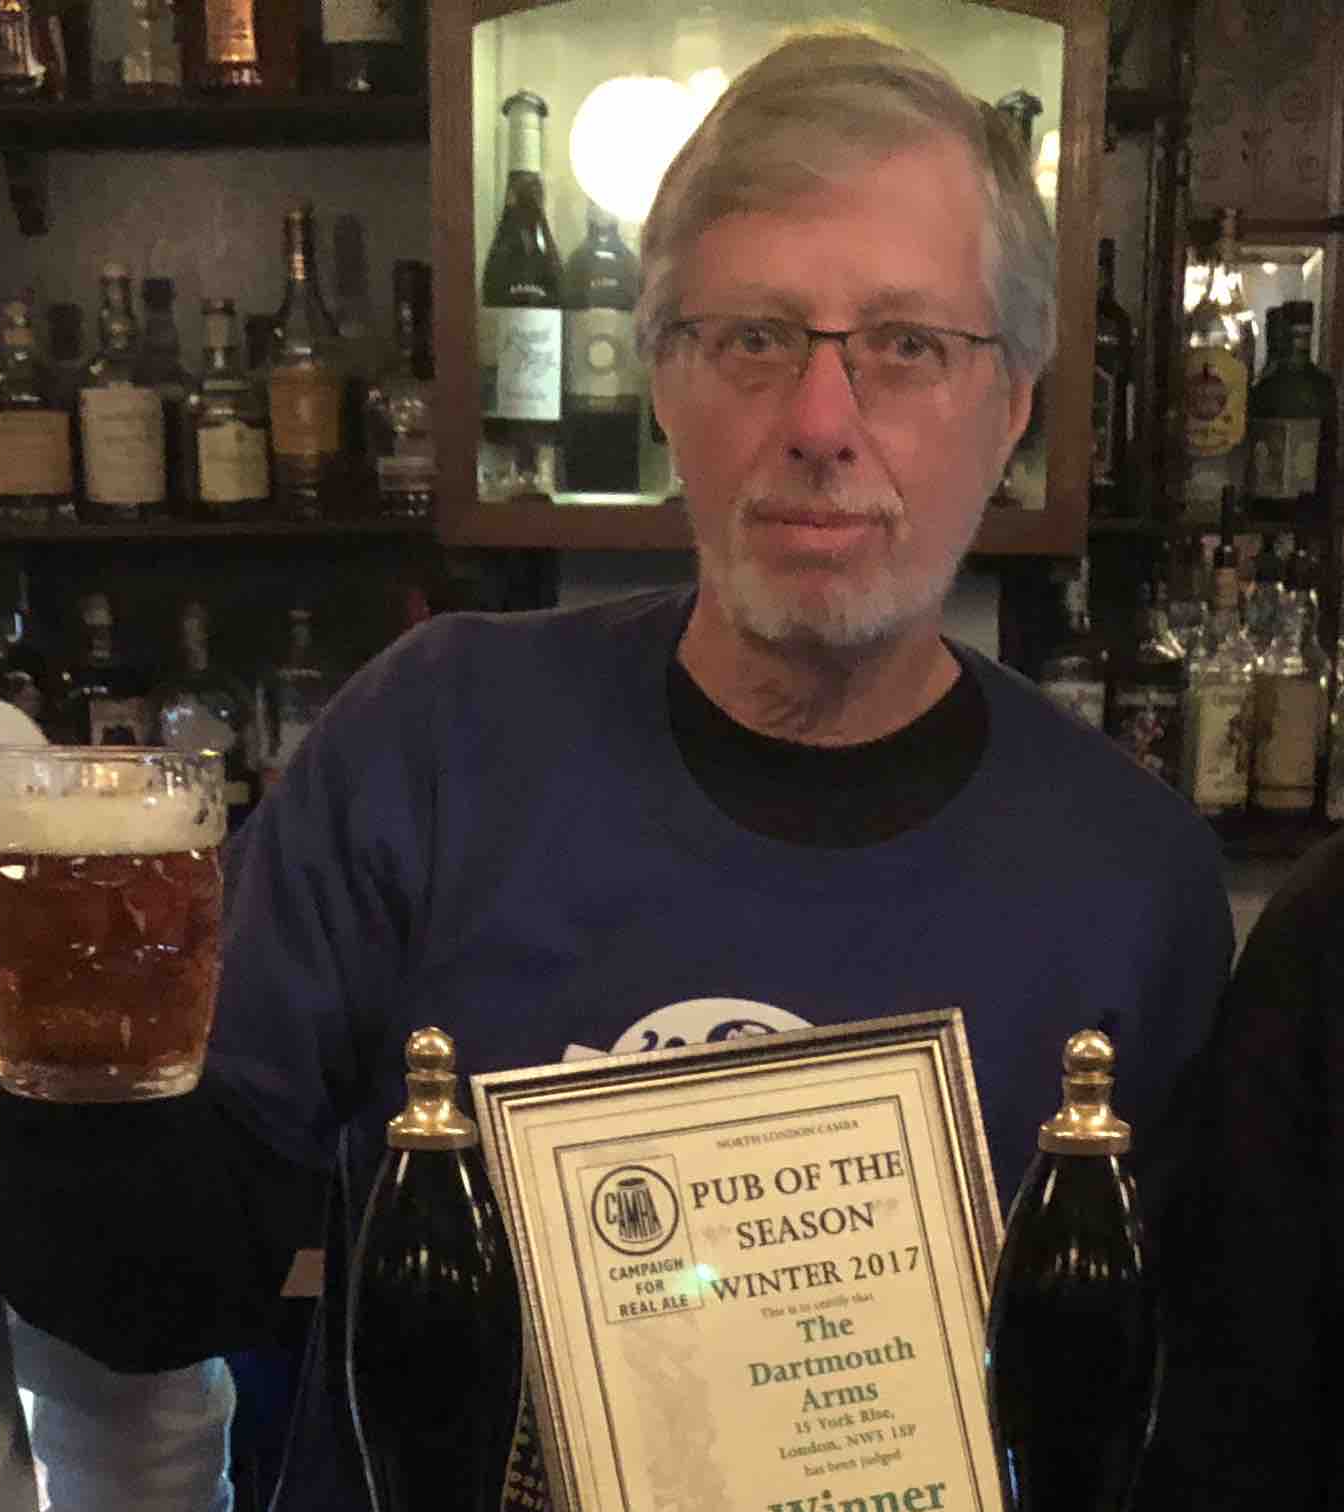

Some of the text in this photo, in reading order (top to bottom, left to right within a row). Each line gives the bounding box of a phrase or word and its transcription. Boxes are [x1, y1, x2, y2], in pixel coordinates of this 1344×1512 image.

[763, 1127, 815, 1145] LONDON
[690, 1150, 905, 1209] PUB OF THE
[736, 1201, 876, 1251] SEASON
[609, 1257, 685, 1282] CAMPAIGN
[710, 1246, 921, 1305] WINTER 2017
[635, 1279, 665, 1296] FOR
[619, 1293, 689, 1318] REAL ALE
[796, 1315, 856, 1344] The
[748, 1335, 917, 1388] Dartmouth
[801, 1381, 880, 1413] Arms
[816, 1412, 856, 1431] York
[778, 1438, 842, 1461] London,
[828, 1457, 858, 1474] been
